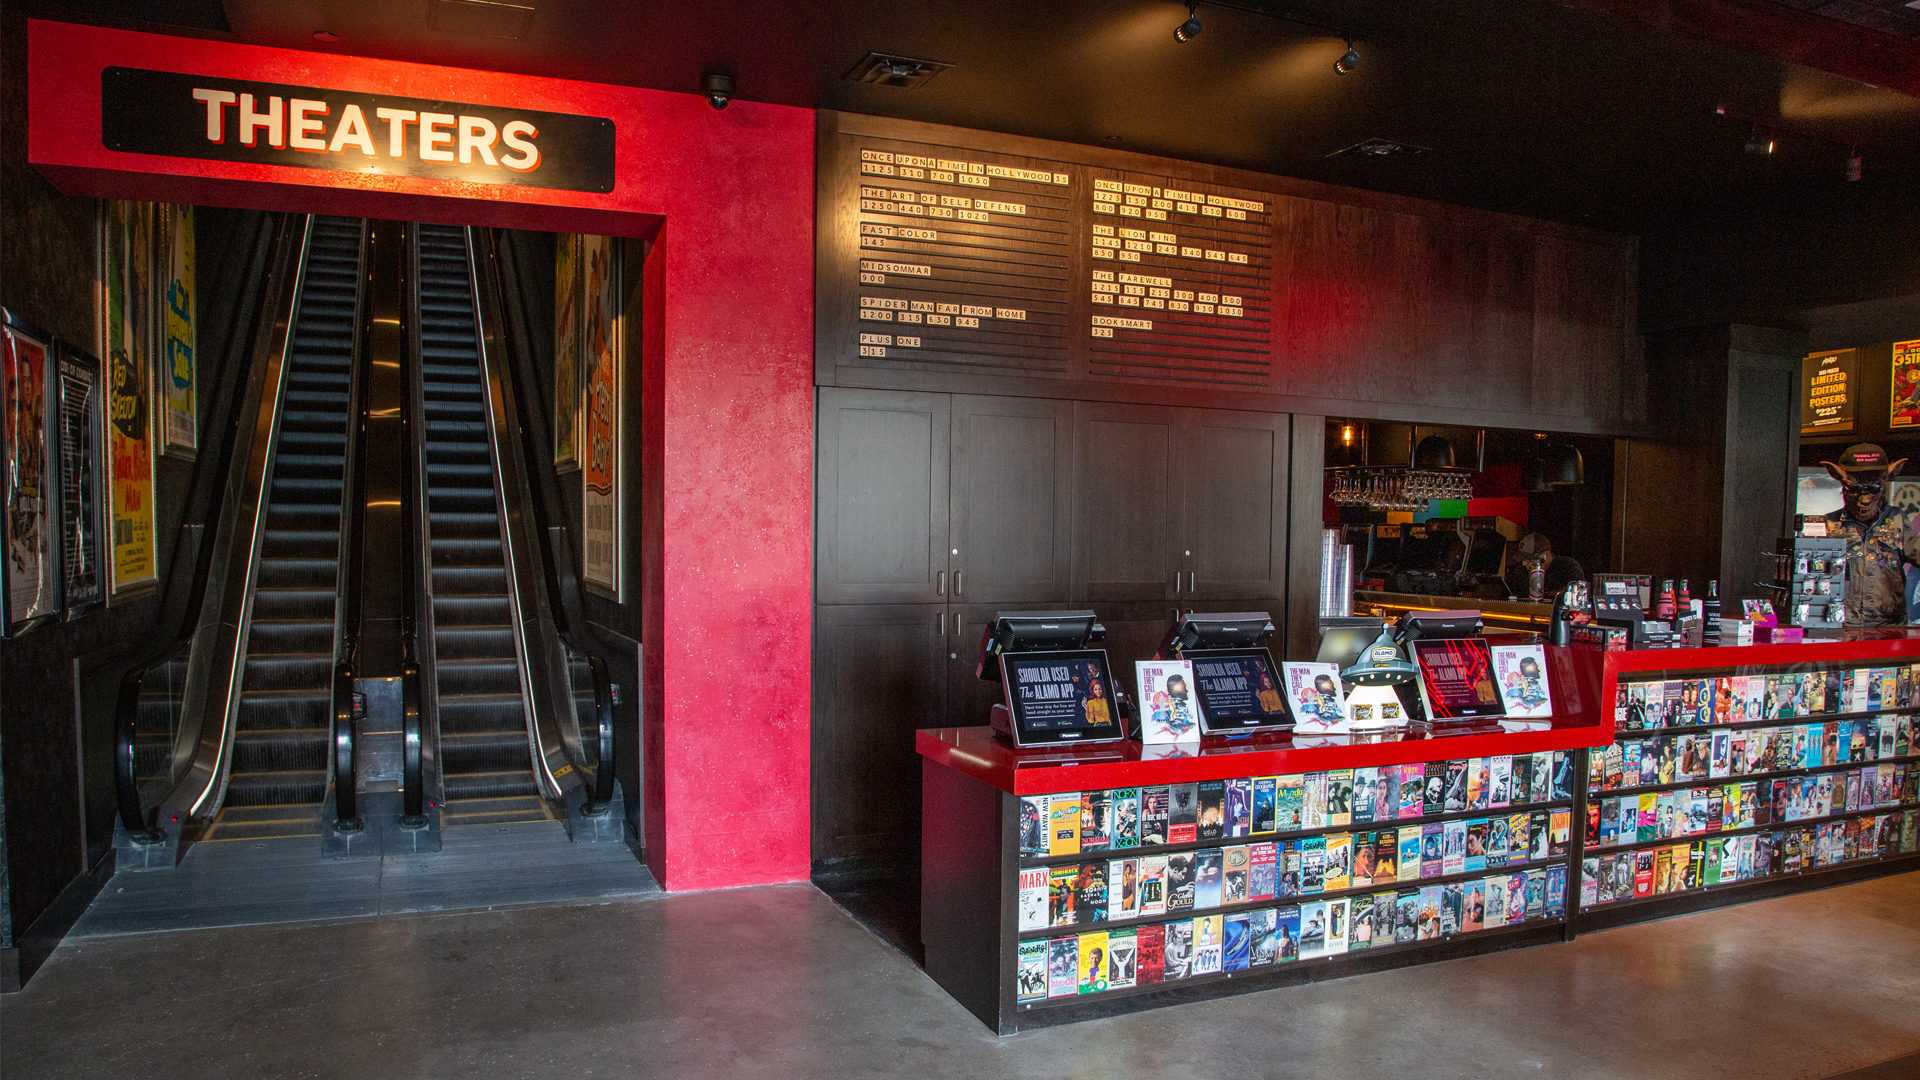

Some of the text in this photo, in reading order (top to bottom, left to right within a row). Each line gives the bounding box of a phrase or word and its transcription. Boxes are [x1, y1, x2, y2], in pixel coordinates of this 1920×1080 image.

[192, 87, 542, 179] THEATERS
[862, 152, 892, 162] ONCE
[896, 156, 927, 166] UPON
[938, 160, 966, 171] TIME
[971, 164, 983, 173] IN
[987, 167, 1050, 181] HOLLYWOOD
[1055, 175, 1067, 183] 35
[864, 164, 988, 185] 1125 310 700 1050
[864, 189, 1025, 213] THE ART OF SELF DEFENSE
[1096, 181, 1121, 190] ONCE
[1125, 185, 1150, 194] UPON
[1165, 190, 1189, 200] TIME
[1193, 194, 1204, 202] IN
[1208, 197, 1263, 211] HOLLYWOOD
[864, 201, 987, 221] 1250 440 730 1020
[1095, 204, 1165, 219] 800 920 950
[1096, 193, 1120, 201] 1225
[1128, 197, 1145, 205] 130
[1154, 200, 1172, 208] 200
[1178, 204, 1196, 212] 415
[1228, 211, 1245, 219] 600
[862, 226, 935, 239] FAST COLOR
[1095, 227, 1175, 242] THE LION KING
[864, 238, 885, 247] 145
[1095, 238, 1120, 247] 1145
[1127, 242, 1151, 250] 1210
[1183, 249, 1201, 257] 340
[861, 262, 930, 275] MIDSOMMAR
[862, 275, 883, 283] 900
[1094, 272, 1170, 286] THE FAREWELL
[1094, 284, 1119, 292] 1215
[1126, 286, 1144, 294] 115
[1175, 292, 1193, 300] 300
[1224, 297, 1241, 305] 500
[862, 299, 1025, 319] SPIDER MAN FAR FROM HOME
[1120, 297, 1138, 305] 645
[1145, 300, 1163, 308] 745
[1170, 303, 1188, 311] 830
[1195, 305, 1213, 313] 930
[1219, 307, 1242, 316] 1030
[862, 311, 978, 326] 1200 315 630 945
[1094, 318, 1151, 328] BOOKSMART
[862, 335, 919, 346] PLUS ONE
[862, 347, 884, 356] 315
[1811, 372, 1847, 387] LIMITED
[1811, 383, 1846, 397] EDITION
[1810, 394, 1847, 409] POSTERS
[1425, 653, 1450, 666] SHOULDA
[1018, 667, 1070, 683] SHOULDA USED
[1143, 668, 1163, 676] THE MAN
[1196, 663, 1242, 676] SHOULDA USED
[1020, 684, 1074, 699] The ALAMO APP
[1200, 677, 1248, 691] The ALAMO APP
[1020, 872, 1048, 889] MARX
[1599, 892, 1613, 902] NOVA
[1051, 978, 1075, 988] BLOOD
